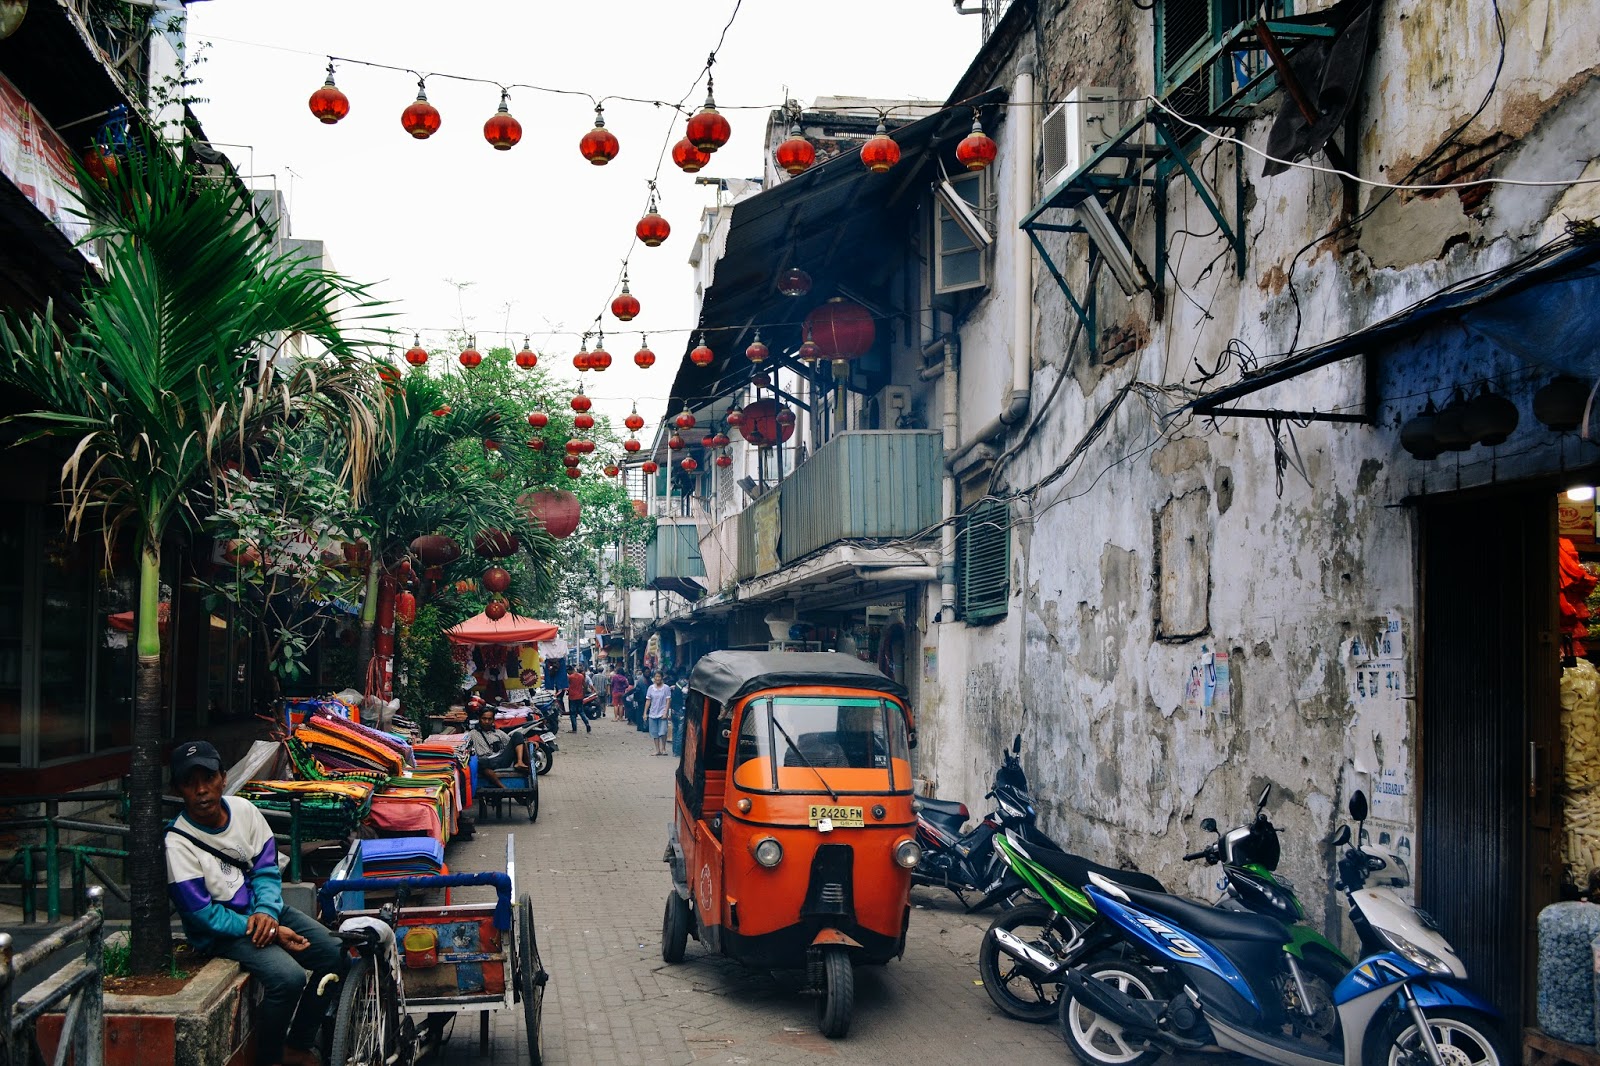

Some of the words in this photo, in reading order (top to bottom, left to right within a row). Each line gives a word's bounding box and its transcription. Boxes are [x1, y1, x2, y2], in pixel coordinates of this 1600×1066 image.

[186, 745, 197, 757] S
[811, 807, 818, 818] B
[850, 808, 862, 818] FN
[1353, 975, 1369, 988] YAMAHA
